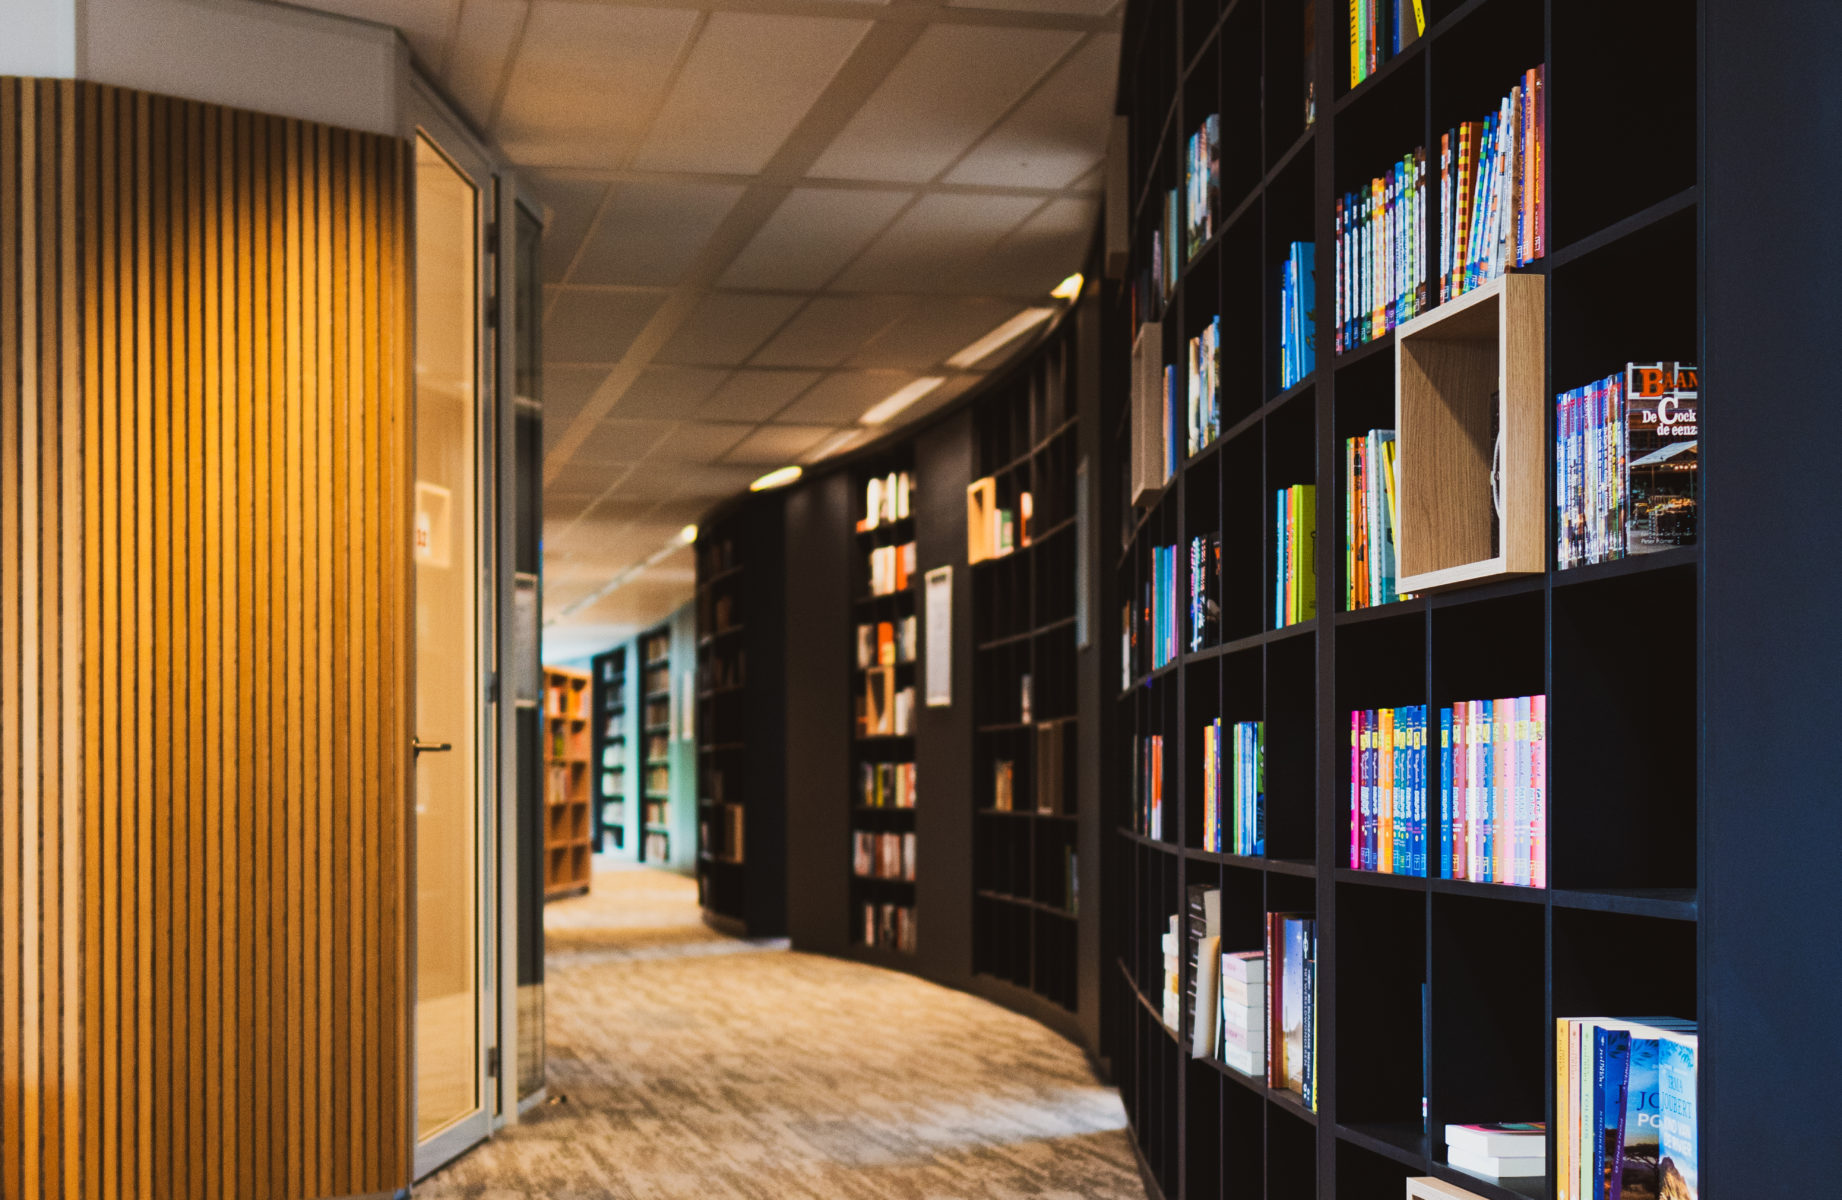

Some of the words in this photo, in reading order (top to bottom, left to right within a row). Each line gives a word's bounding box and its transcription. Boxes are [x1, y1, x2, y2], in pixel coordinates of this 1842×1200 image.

[1642, 410, 1657, 423] De
[1658, 397, 1696, 424] Cock
[1657, 423, 1670, 436] de
